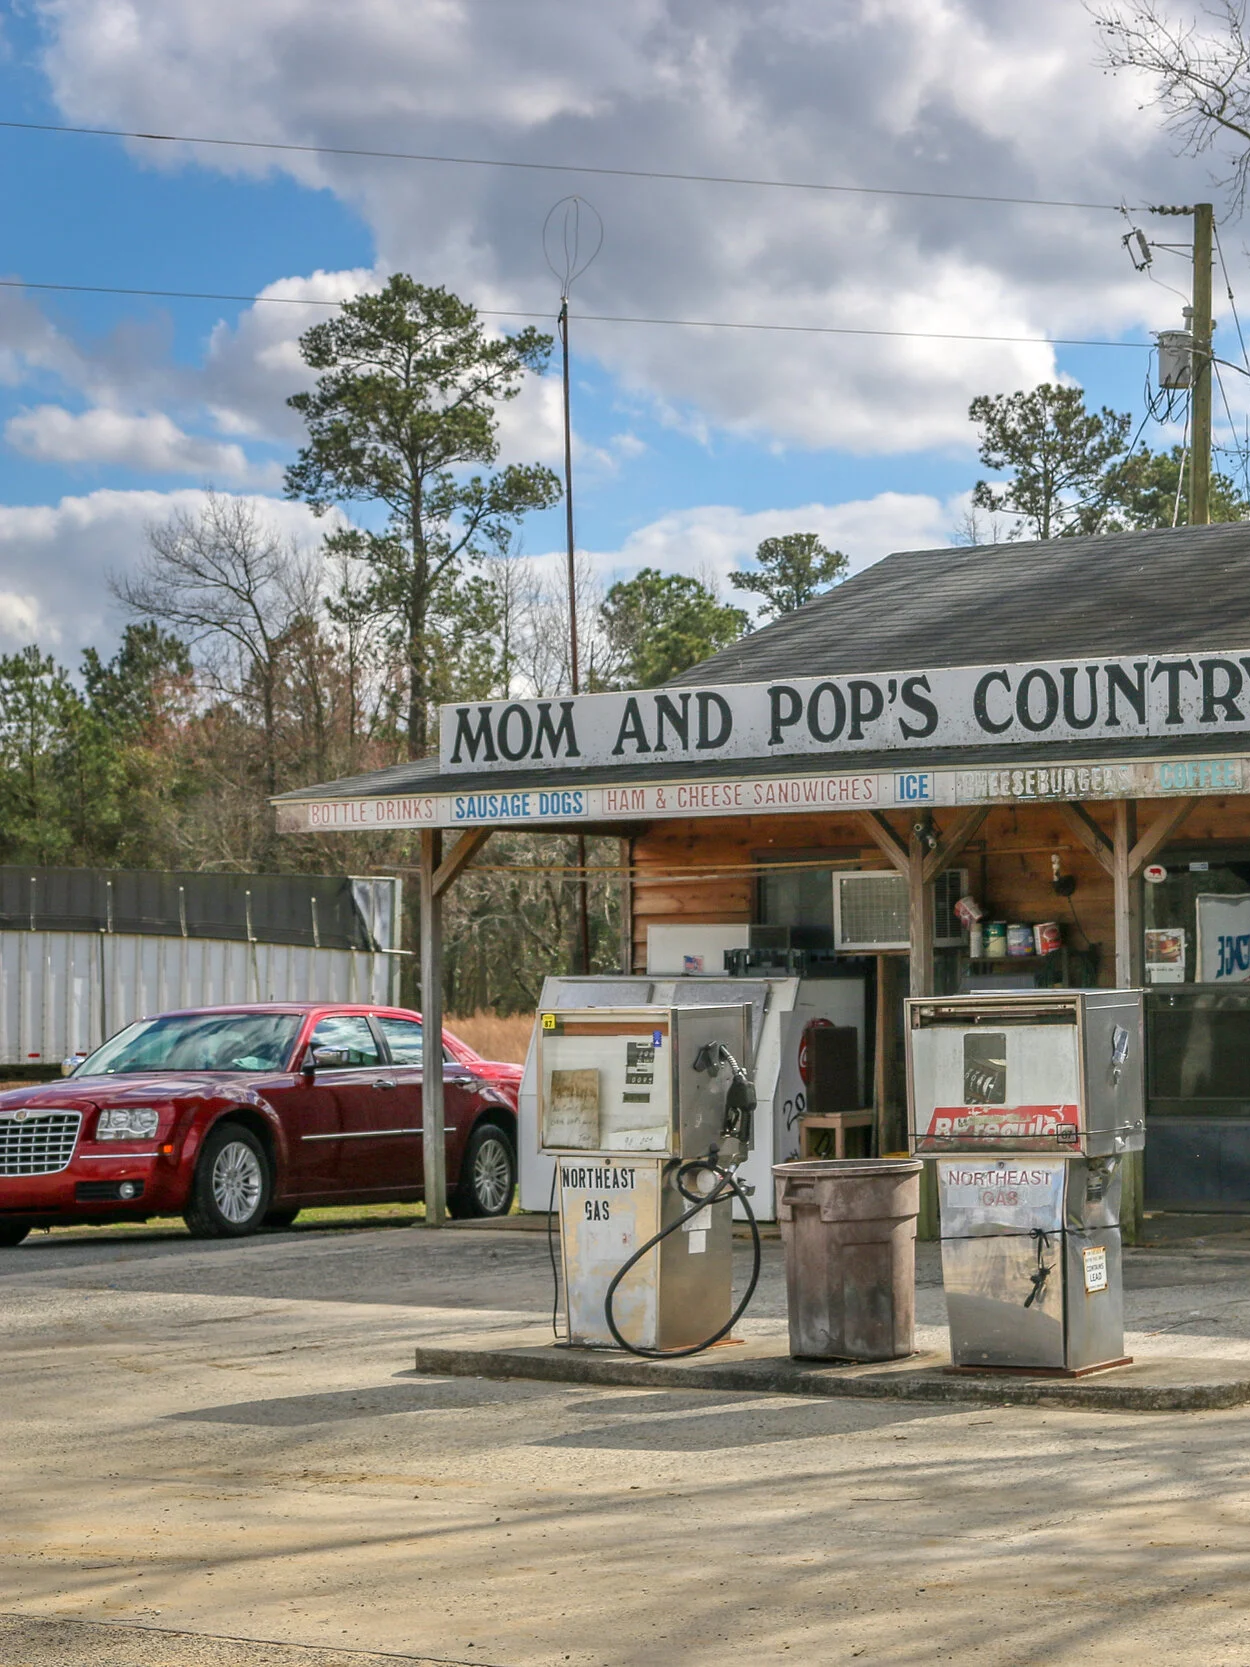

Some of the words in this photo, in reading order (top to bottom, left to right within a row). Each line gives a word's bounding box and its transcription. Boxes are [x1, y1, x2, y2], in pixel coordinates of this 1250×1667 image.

[450, 700, 582, 765] MOM
[611, 691, 733, 756] AND
[767, 674, 939, 747] POP'S
[899, 774, 929, 800] ICE
[962, 766, 1130, 797] CHEESEBURGERS
[1159, 760, 1238, 789] COFFEE
[455, 793, 532, 820] SAUSAGE
[538, 791, 584, 816] DOGS
[606, 788, 646, 812] HAM
[655, 787, 667, 808] &
[676, 783, 743, 808] CHEESE
[753, 776, 874, 805] SANDWICHES
[310, 800, 370, 826] BOTTLE
[375, 798, 434, 822] DRINKS
[544, 1020, 553, 1028] 87
[974, 1115, 1068, 1142] regula
[562, 1167, 636, 1189] NORTHEAST
[948, 1170, 1052, 1186] NORTHEAST
[584, 1200, 610, 1221] GAS
[982, 1190, 1019, 1206] GAS
[1090, 1272, 1103, 1282] LEAD
